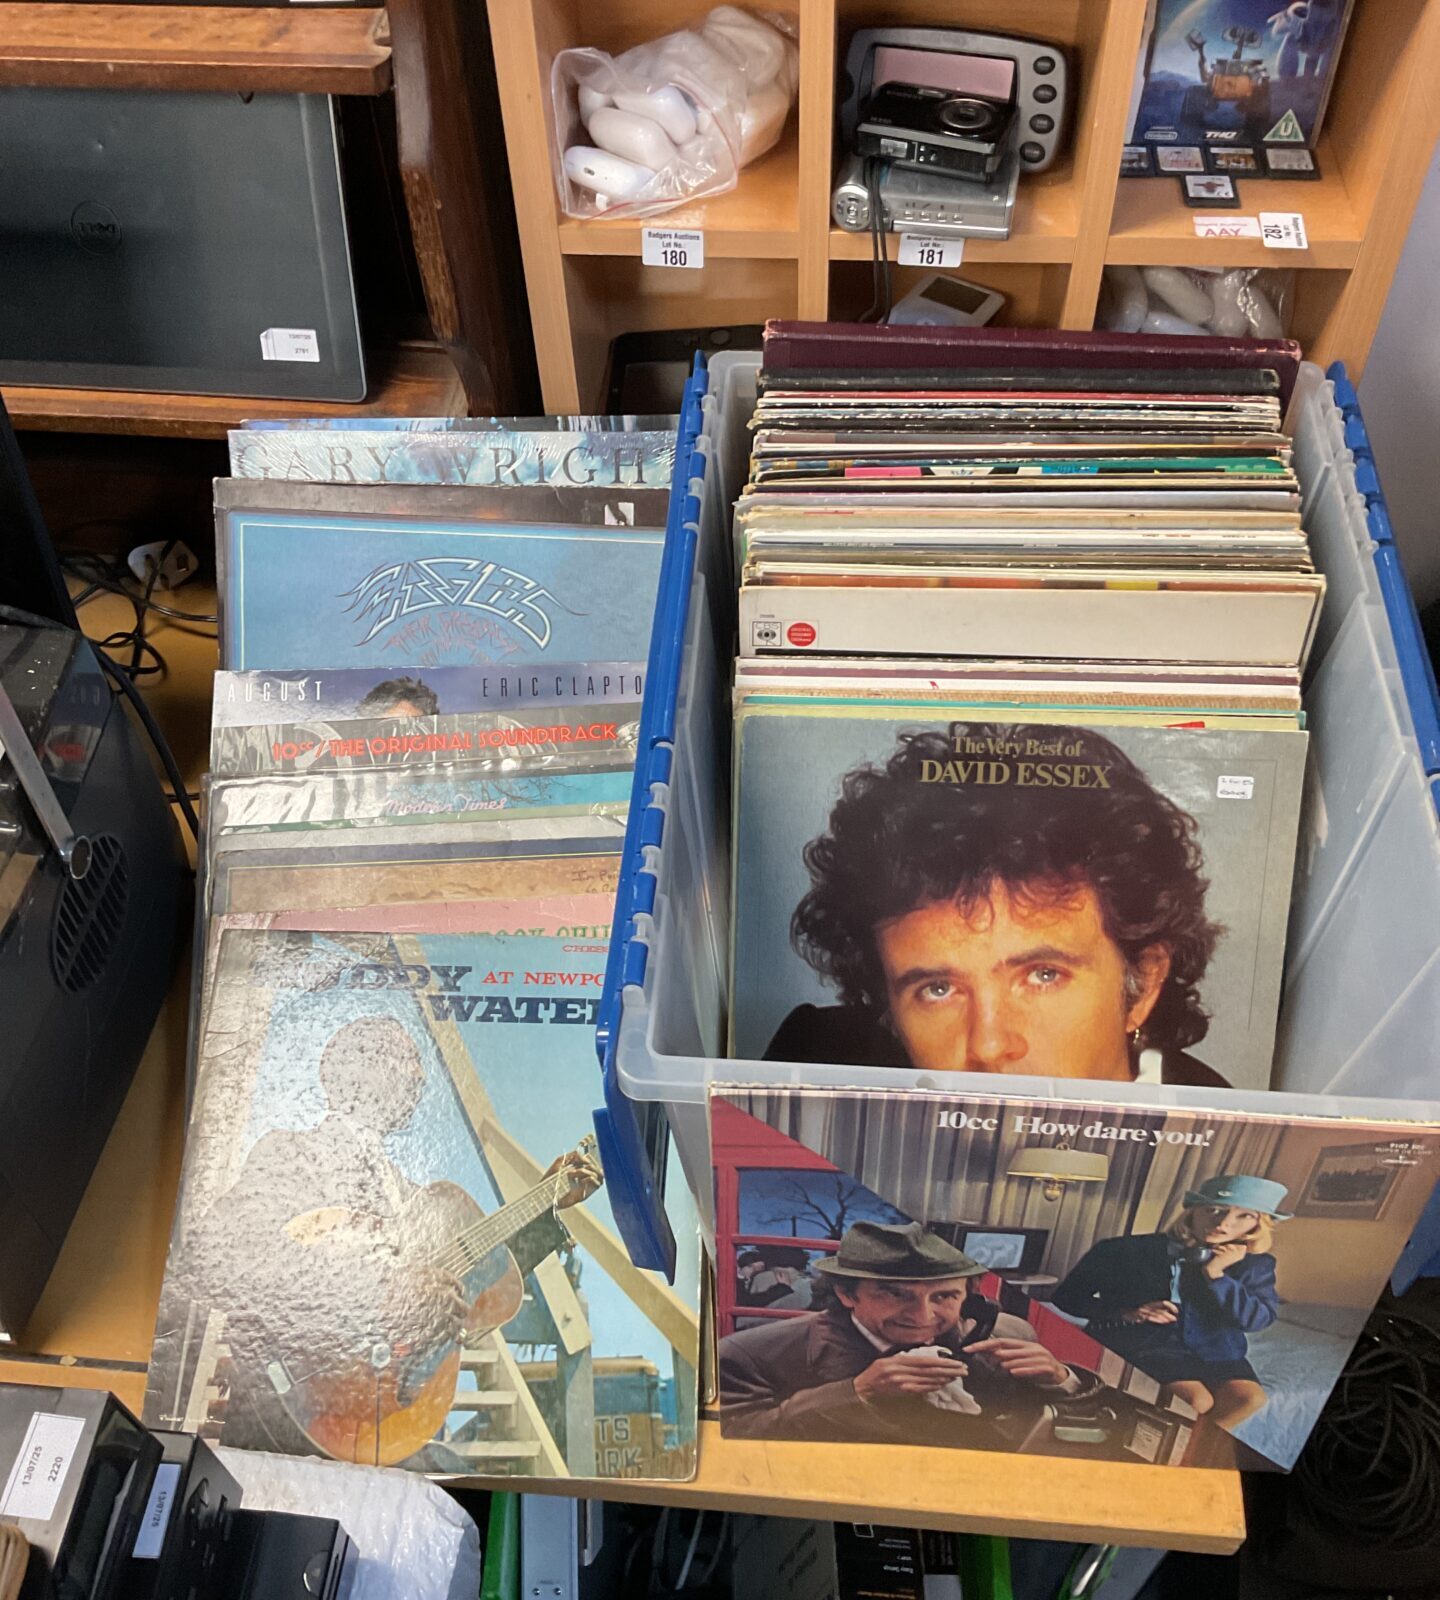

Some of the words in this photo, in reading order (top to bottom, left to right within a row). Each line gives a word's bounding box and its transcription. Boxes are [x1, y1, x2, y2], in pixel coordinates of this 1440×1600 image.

[1280, 123, 1293, 136] U
[1205, 228, 1241, 238] AAY
[1263, 224, 1283, 240] 182
[661, 249, 688, 266] 180
[918, 249, 944, 265] 181
[236, 445, 395, 482] GARY
[340, 557, 585, 650] EAGLES
[228, 681, 322, 702] AUGUST
[482, 676, 539, 698] ERIC
[272, 740, 314, 762] 10cc
[328, 738, 365, 758] THE
[371, 731, 473, 756] ORIGINAL
[480, 723, 619, 748] SOUNDTRACK
[952, 736, 985, 754] The
[986, 737, 1023, 759] Very
[1025, 739, 1063, 757] Best
[1065, 740, 1084, 757] of
[920, 760, 1011, 785] DAVID
[1015, 762, 1114, 789] ESSEX
[383, 799, 453, 815] Modern
[454, 793, 507, 812] Times
[481, 971, 514, 985] AT
[937, 1110, 999, 1131] 10cc
[1013, 1115, 1081, 1137] How
[1083, 1120, 1147, 1142] dare
[1148, 1129, 1216, 1147] you!
[594, 1415, 631, 1444] TS
[21, 1445, 43, 1487] 13/07/25
[47, 1455, 65, 1483] 2220
